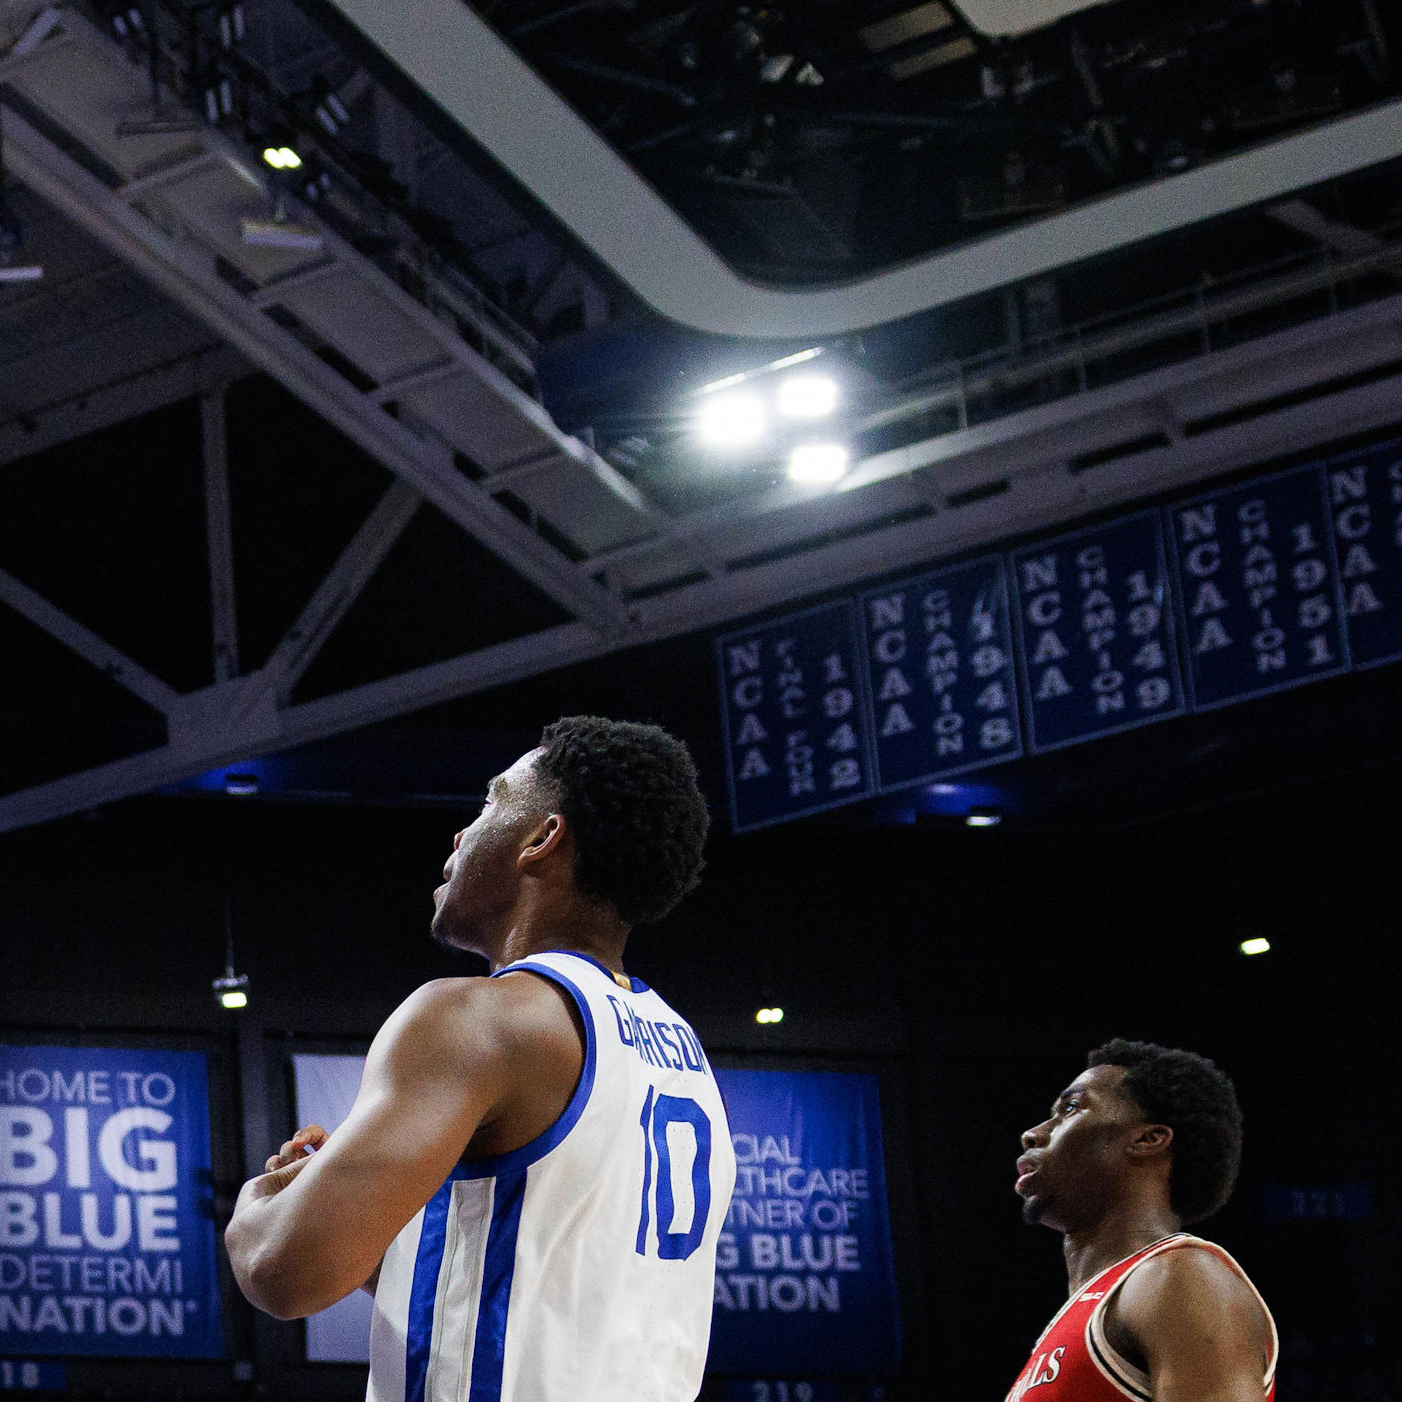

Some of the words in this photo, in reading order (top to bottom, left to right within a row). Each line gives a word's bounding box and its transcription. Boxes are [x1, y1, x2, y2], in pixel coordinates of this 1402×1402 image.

[1179, 504, 1233, 654] NCAA
[1331, 465, 1386, 617] NCAA
[871, 592, 916, 737] NCAA
[1021, 553, 1073, 702] NCAA
[728, 640, 771, 782] NCAA
[119, 1071, 176, 1107] TO
[732, 1133, 802, 1166] CIAL
[636, 1083, 712, 1262] 10
[728, 1200, 804, 1229] TNER
[811, 1201, 859, 1232] OF
[714, 1273, 842, 1313] ATION
[751, 1234, 861, 1272] BLUE
